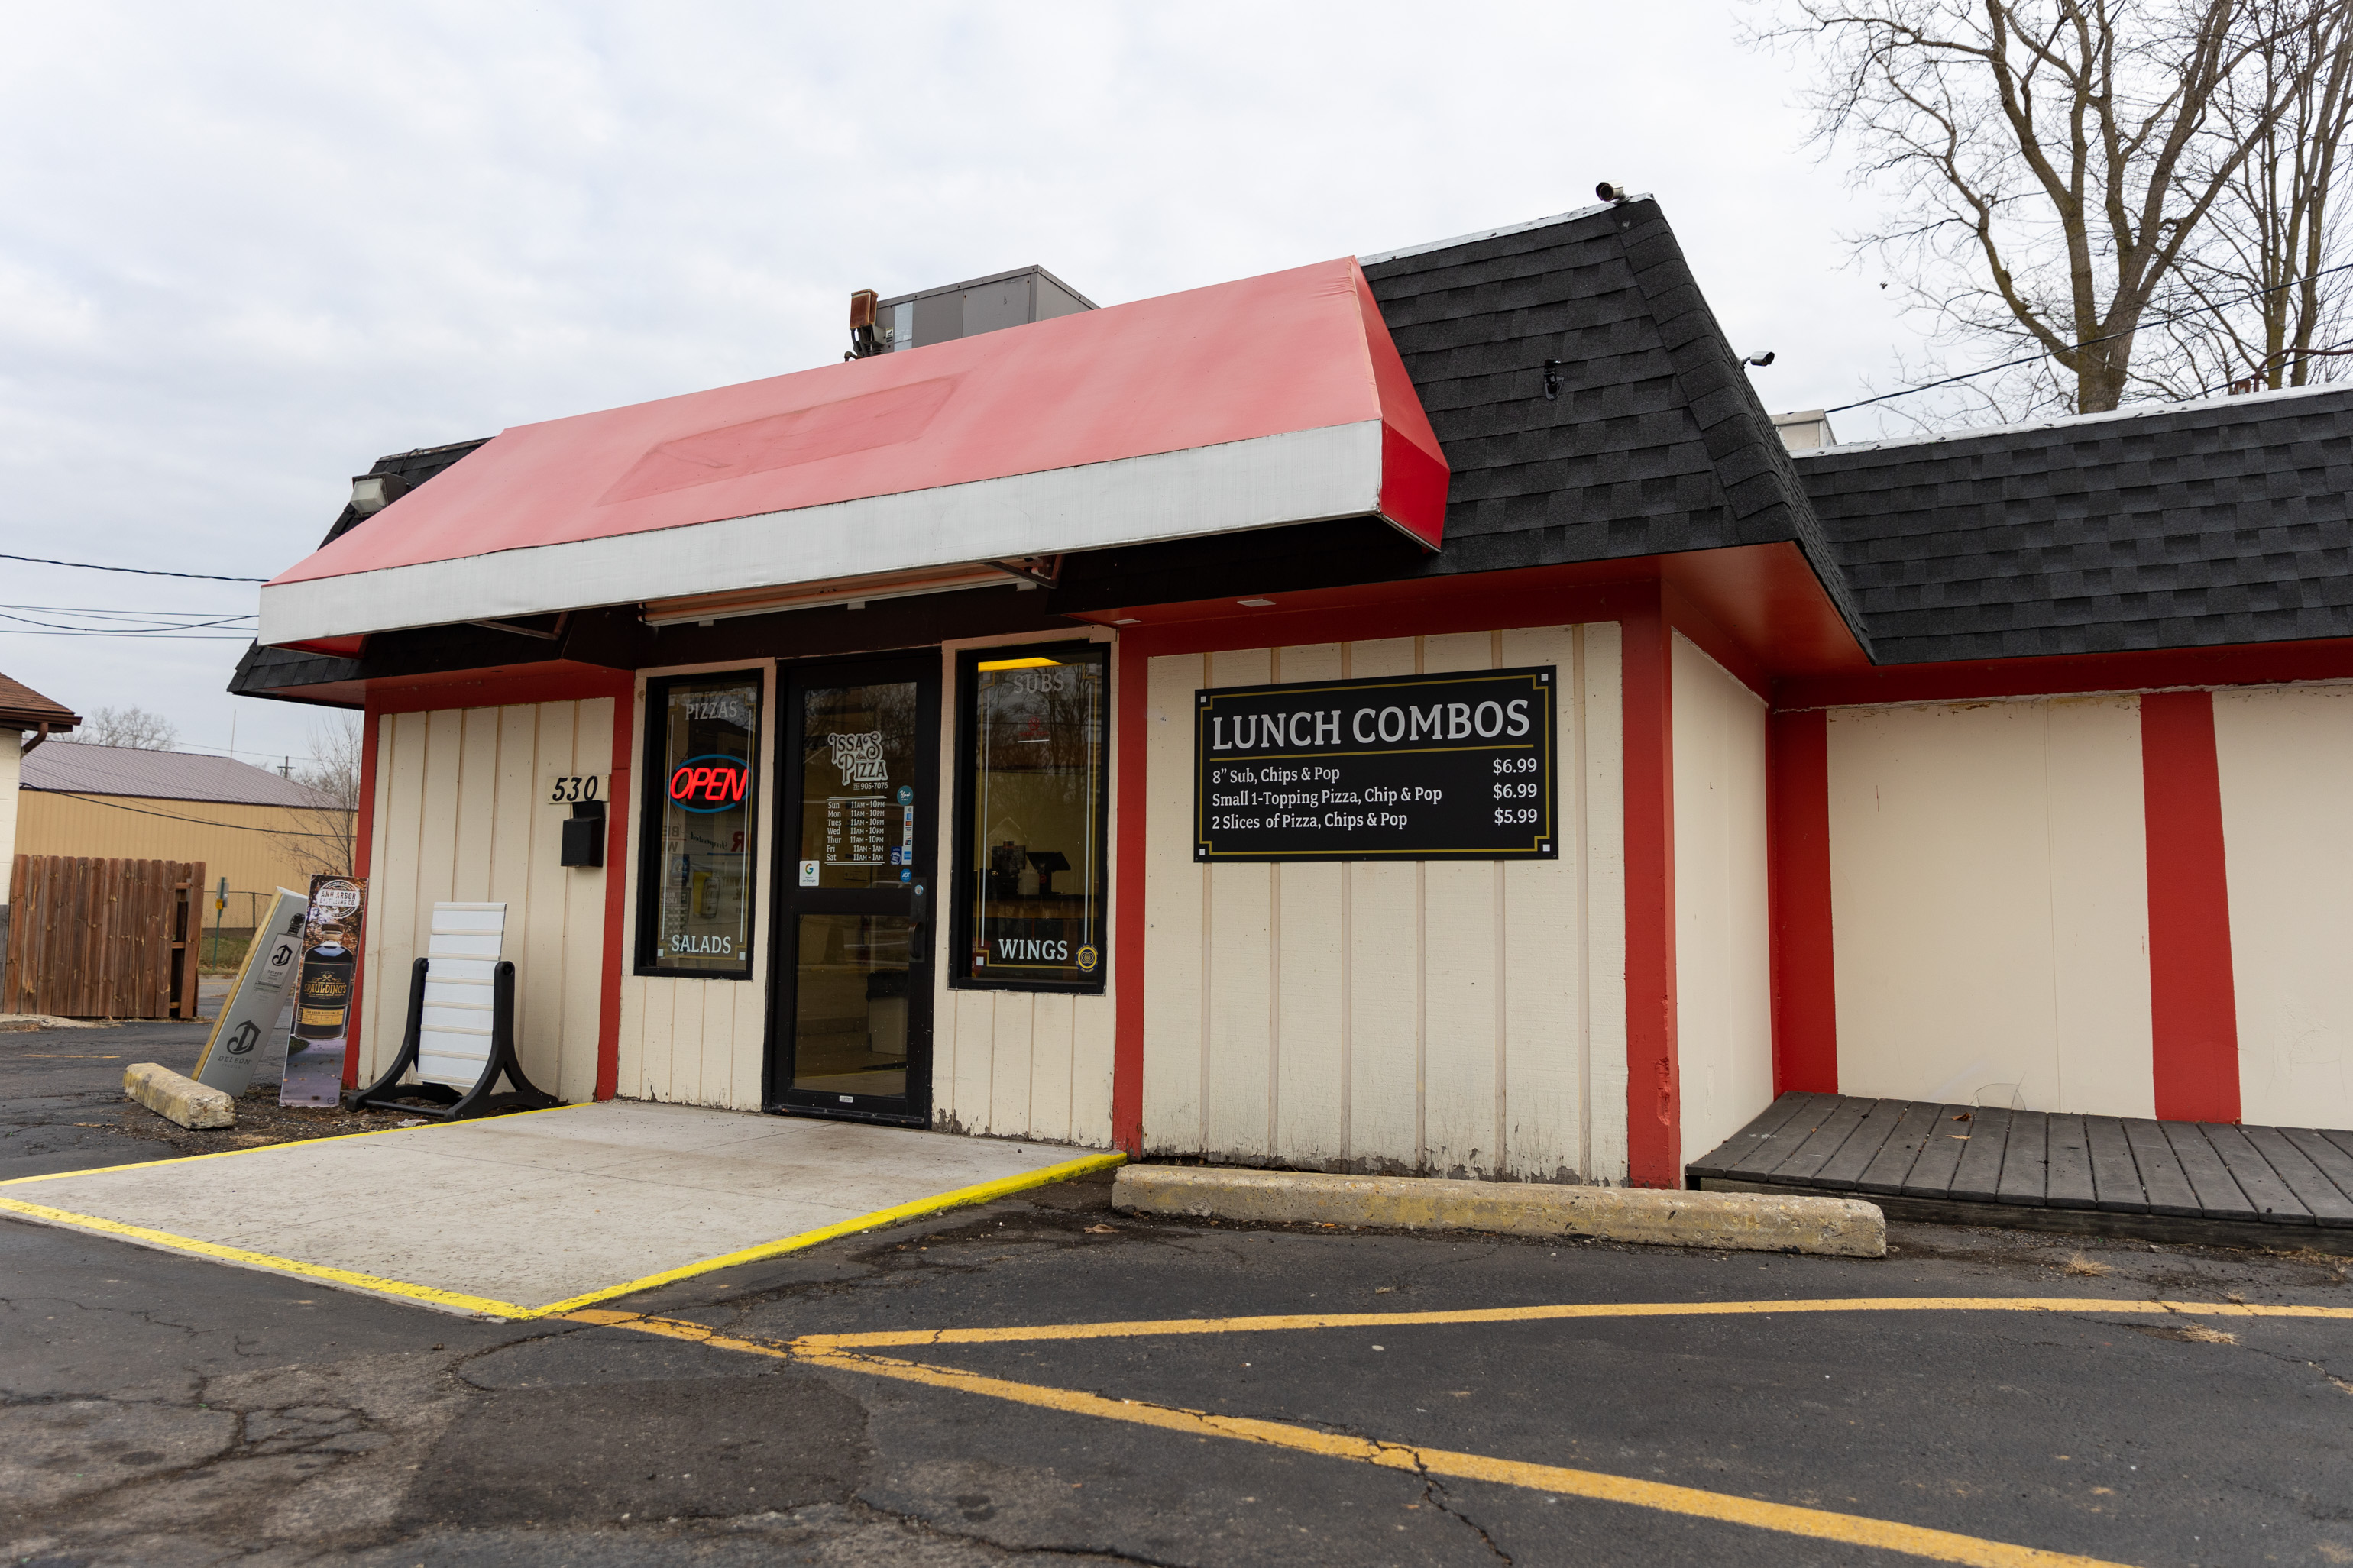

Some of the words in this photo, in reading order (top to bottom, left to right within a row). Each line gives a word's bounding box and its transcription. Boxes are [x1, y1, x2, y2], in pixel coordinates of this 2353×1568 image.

[1013, 672, 1065, 693] SUBS
[685, 700, 738, 720] PIZZAS
[1212, 710, 1342, 750] LUNCH
[1352, 699, 1530, 744] COMBOS
[830, 733, 881, 761] ISSA'S
[838, 754, 886, 783] PIZZA
[1229, 767, 1257, 785] Sub,
[1261, 766, 1298, 785] Chips
[1300, 767, 1311, 781] &
[1314, 766, 1340, 784] Pop
[1493, 757, 1537, 776] $6.99
[552, 775, 599, 802] 530
[669, 767, 749, 801] OPEN
[1493, 782, 1538, 801] $6.99
[1212, 790, 1248, 807] Small
[1251, 789, 1319, 809] 1-Topping
[1321, 788, 1361, 806] Pizza,
[1364, 786, 1397, 807] Chip
[1400, 787, 1412, 801] &
[1414, 787, 1442, 805] Pop
[1212, 816, 1220, 829] 2
[1222, 813, 1261, 829] Slices
[1265, 813, 1280, 829] of
[1282, 813, 1322, 830] Pizza,
[1324, 811, 1364, 831] Chips
[1367, 812, 1377, 826] &
[1380, 812, 1408, 830] Pop
[1494, 807, 1538, 826] $5.99
[671, 934, 732, 955] SALADS
[998, 939, 1069, 961] WINGS
[304, 983, 347, 994] SPAULDING'S
